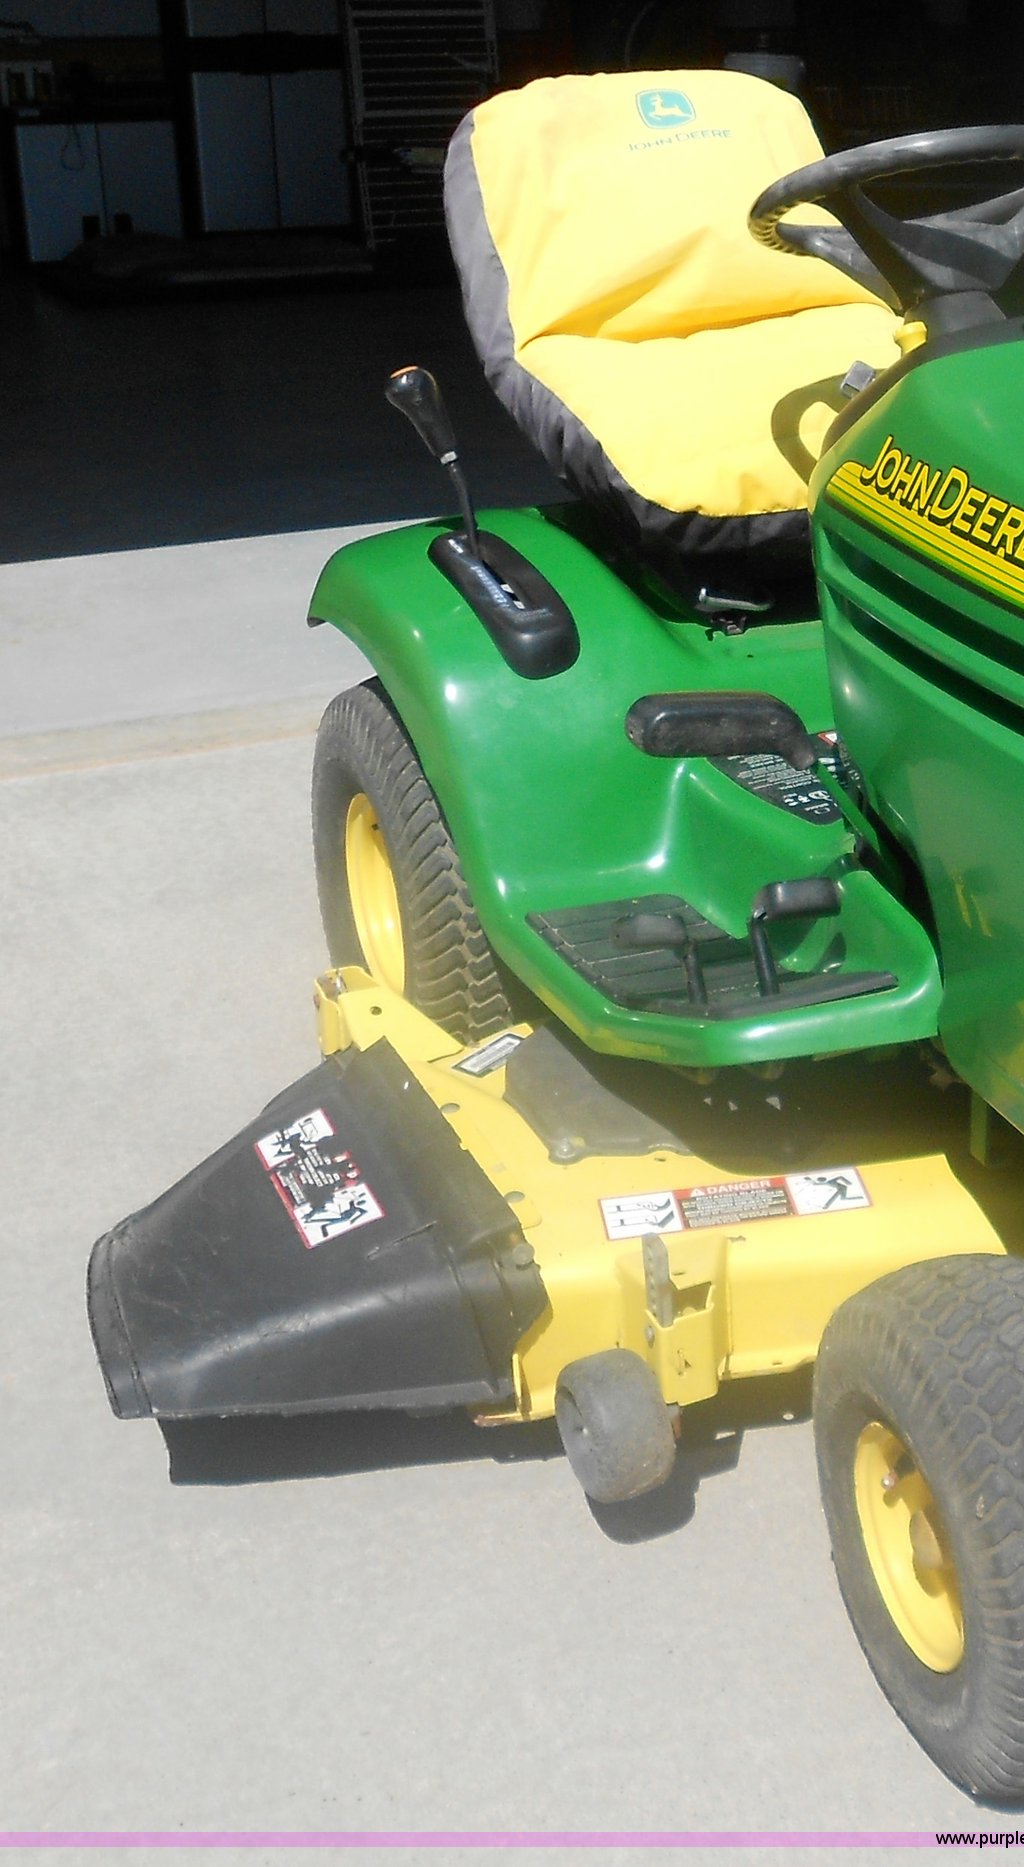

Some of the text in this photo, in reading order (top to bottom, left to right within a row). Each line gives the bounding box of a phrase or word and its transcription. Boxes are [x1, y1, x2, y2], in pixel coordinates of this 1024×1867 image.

[628, 129, 733, 152] JOHN DEERE
[706, 1179, 772, 1196] DANGER
